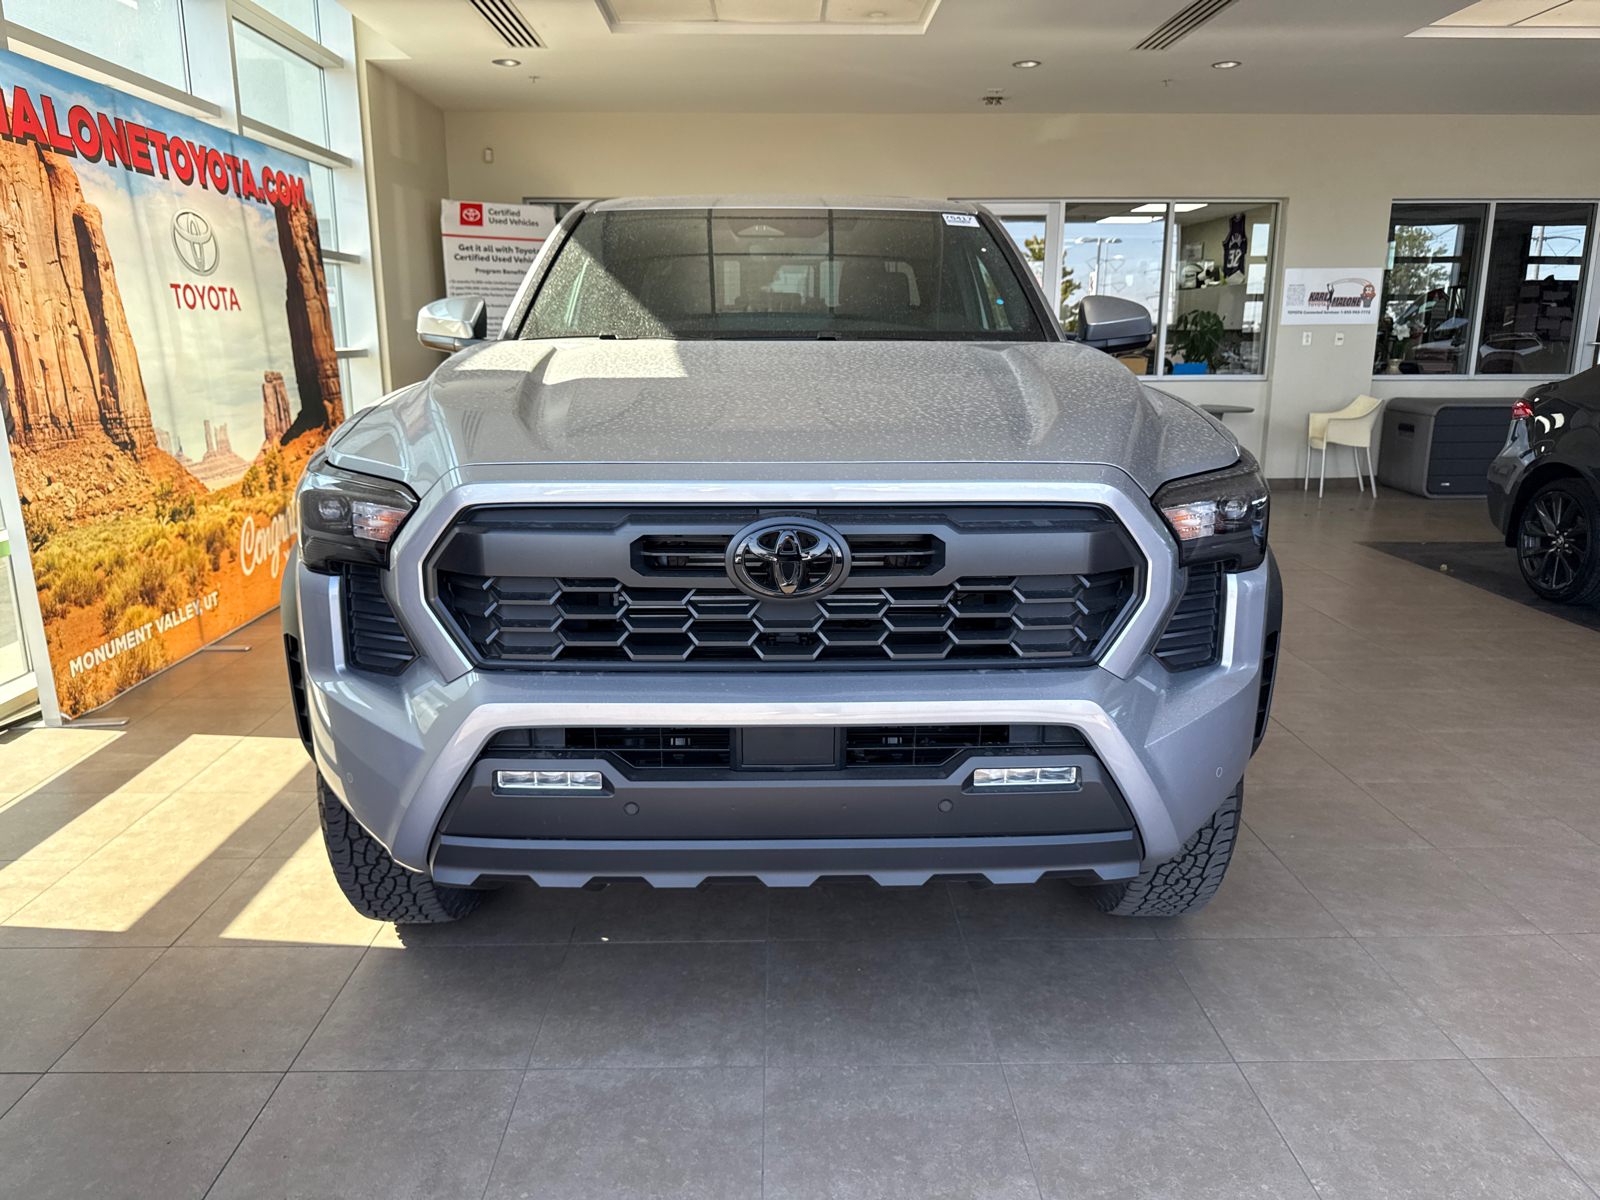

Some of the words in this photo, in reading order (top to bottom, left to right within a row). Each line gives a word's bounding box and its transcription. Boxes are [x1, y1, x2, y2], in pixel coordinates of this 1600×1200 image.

[488, 208, 521, 217] Certified
[488, 217, 508, 225] Used
[509, 218, 539, 227] Vehicles
[458, 244, 474, 252] Get
[483, 245, 494, 253] all
[495, 246, 514, 254] with
[454, 253, 490, 262] Certified
[1227, 249, 1242, 268] 32
[475, 267, 501, 275] Program
[169, 282, 242, 311] TOYOTA
[1331, 297, 1361, 307] MALONE
[68, 622, 153, 678] MONUMENT
[155, 600, 204, 635] VALLEY,
[203, 591, 219, 613] UT
